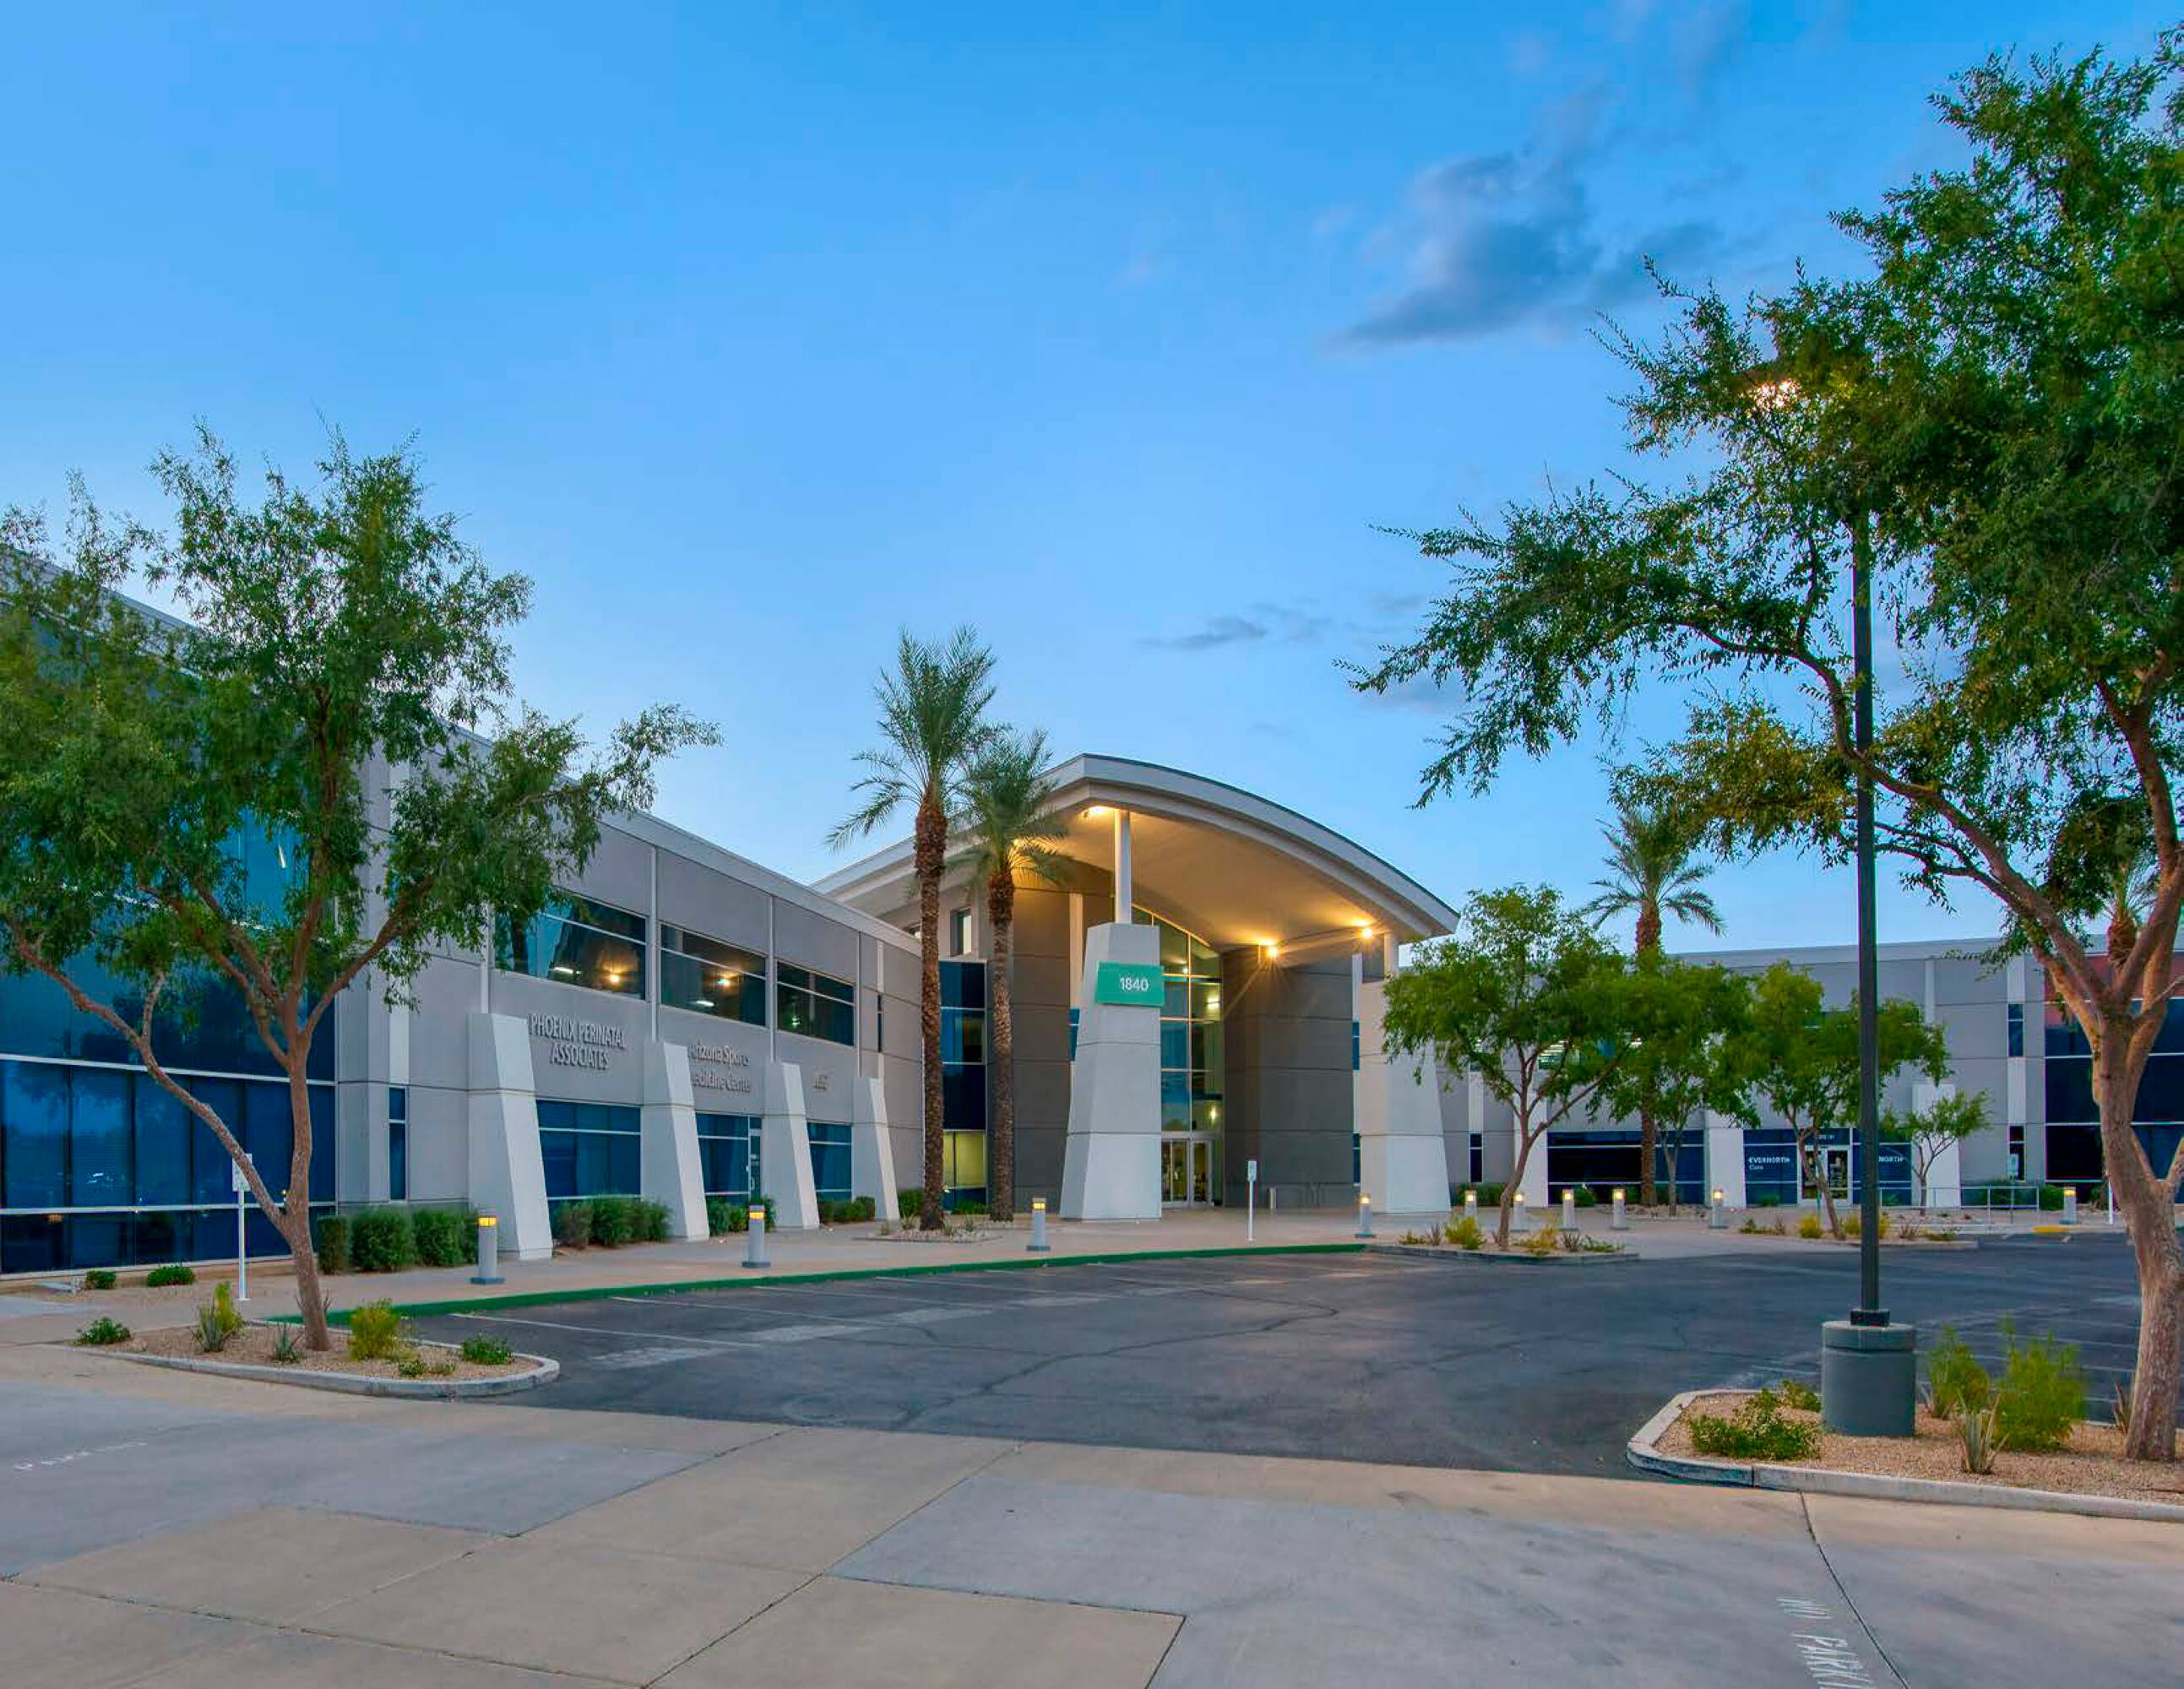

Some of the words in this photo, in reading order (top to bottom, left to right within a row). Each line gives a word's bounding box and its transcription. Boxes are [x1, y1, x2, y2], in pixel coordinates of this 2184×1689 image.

[1119, 977, 1149, 991] 1840
[528, 1013, 574, 1042] PHOENIX
[578, 1021, 626, 1051] PERINATAL
[550, 1043, 609, 1071] ASSOCIATES
[692, 1071, 725, 1090] edicine
